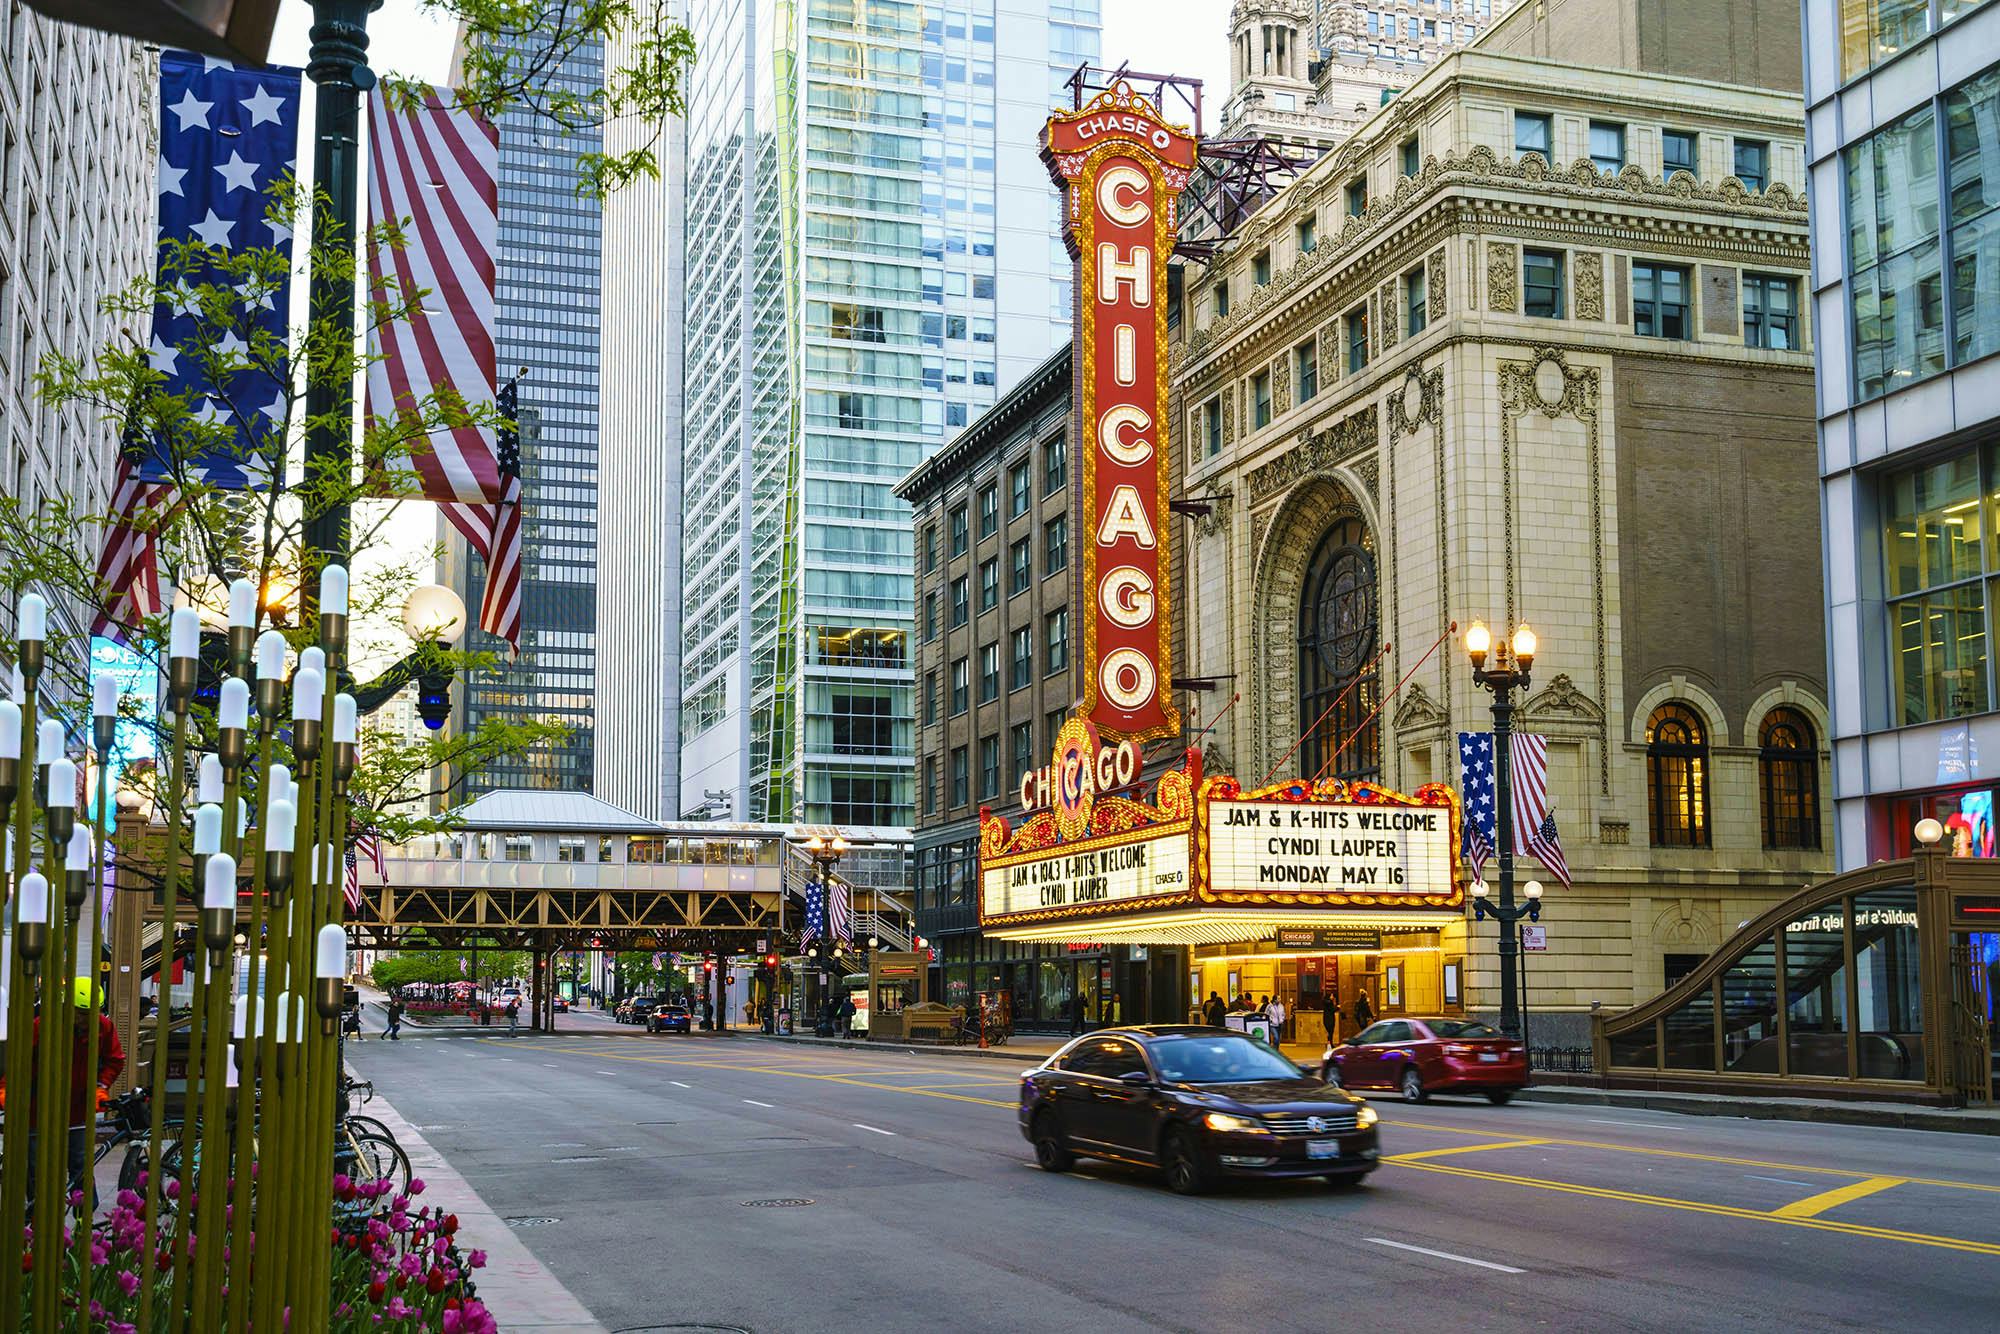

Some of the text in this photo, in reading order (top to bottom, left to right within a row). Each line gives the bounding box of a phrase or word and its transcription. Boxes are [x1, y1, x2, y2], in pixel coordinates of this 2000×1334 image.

[1076, 115, 1150, 139] CHASE
[1096, 166, 1156, 711] CHICAGO
[1021, 740, 1134, 811] CHICAGO
[1224, 808, 1436, 831] JAM & K-HITS WELCOME
[1268, 838, 1397, 857] CYNDI LAUPER
[1012, 865, 1028, 887] JAM
[1065, 853, 1095, 879] K-HITS
[1100, 844, 1146, 873] WELCOME
[1260, 865, 1404, 884] MONDAY MAY 16
[1155, 872, 1176, 885] CHASE
[1040, 877, 1108, 906] CYNDI LAUPER
